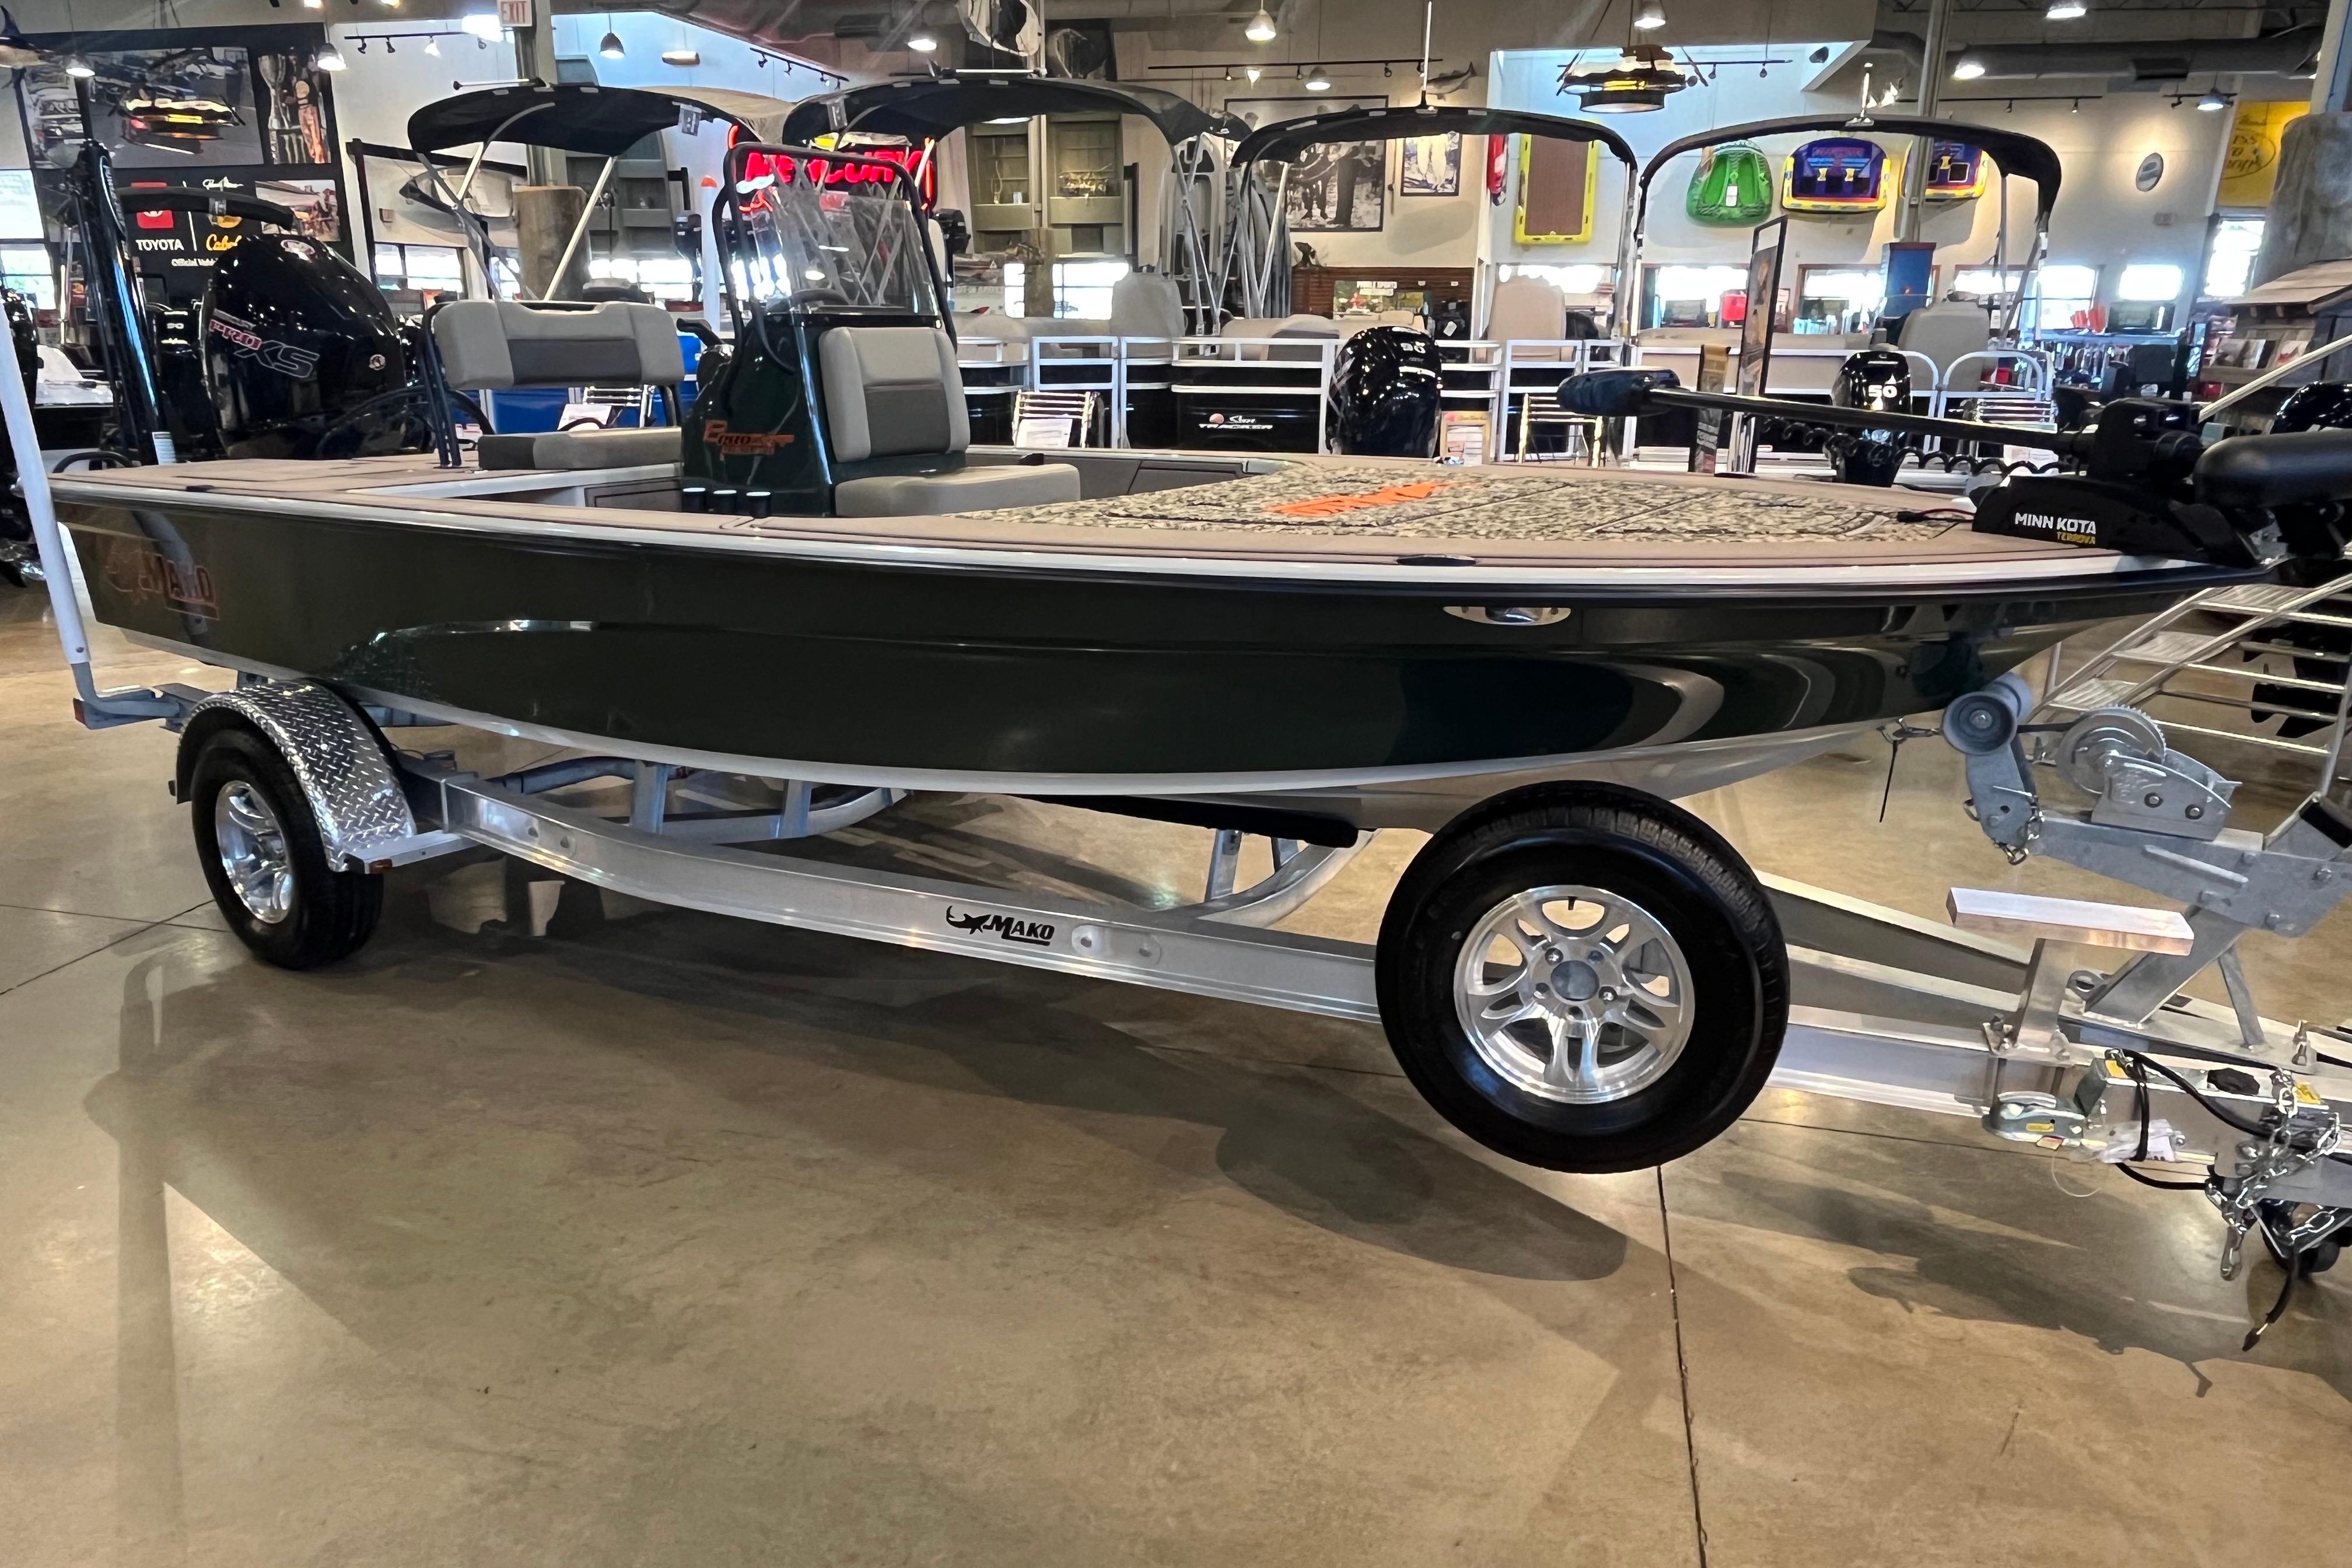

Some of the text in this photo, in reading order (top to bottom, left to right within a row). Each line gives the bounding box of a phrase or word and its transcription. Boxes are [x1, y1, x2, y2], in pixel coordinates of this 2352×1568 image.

[501, 1, 527, 24] EXIT
[135, 239, 185, 251] TOYOTA
[1868, 384, 1898, 398] 50
[2015, 512, 2096, 535] MINN KOTA
[982, 914, 1055, 946] MAKO
